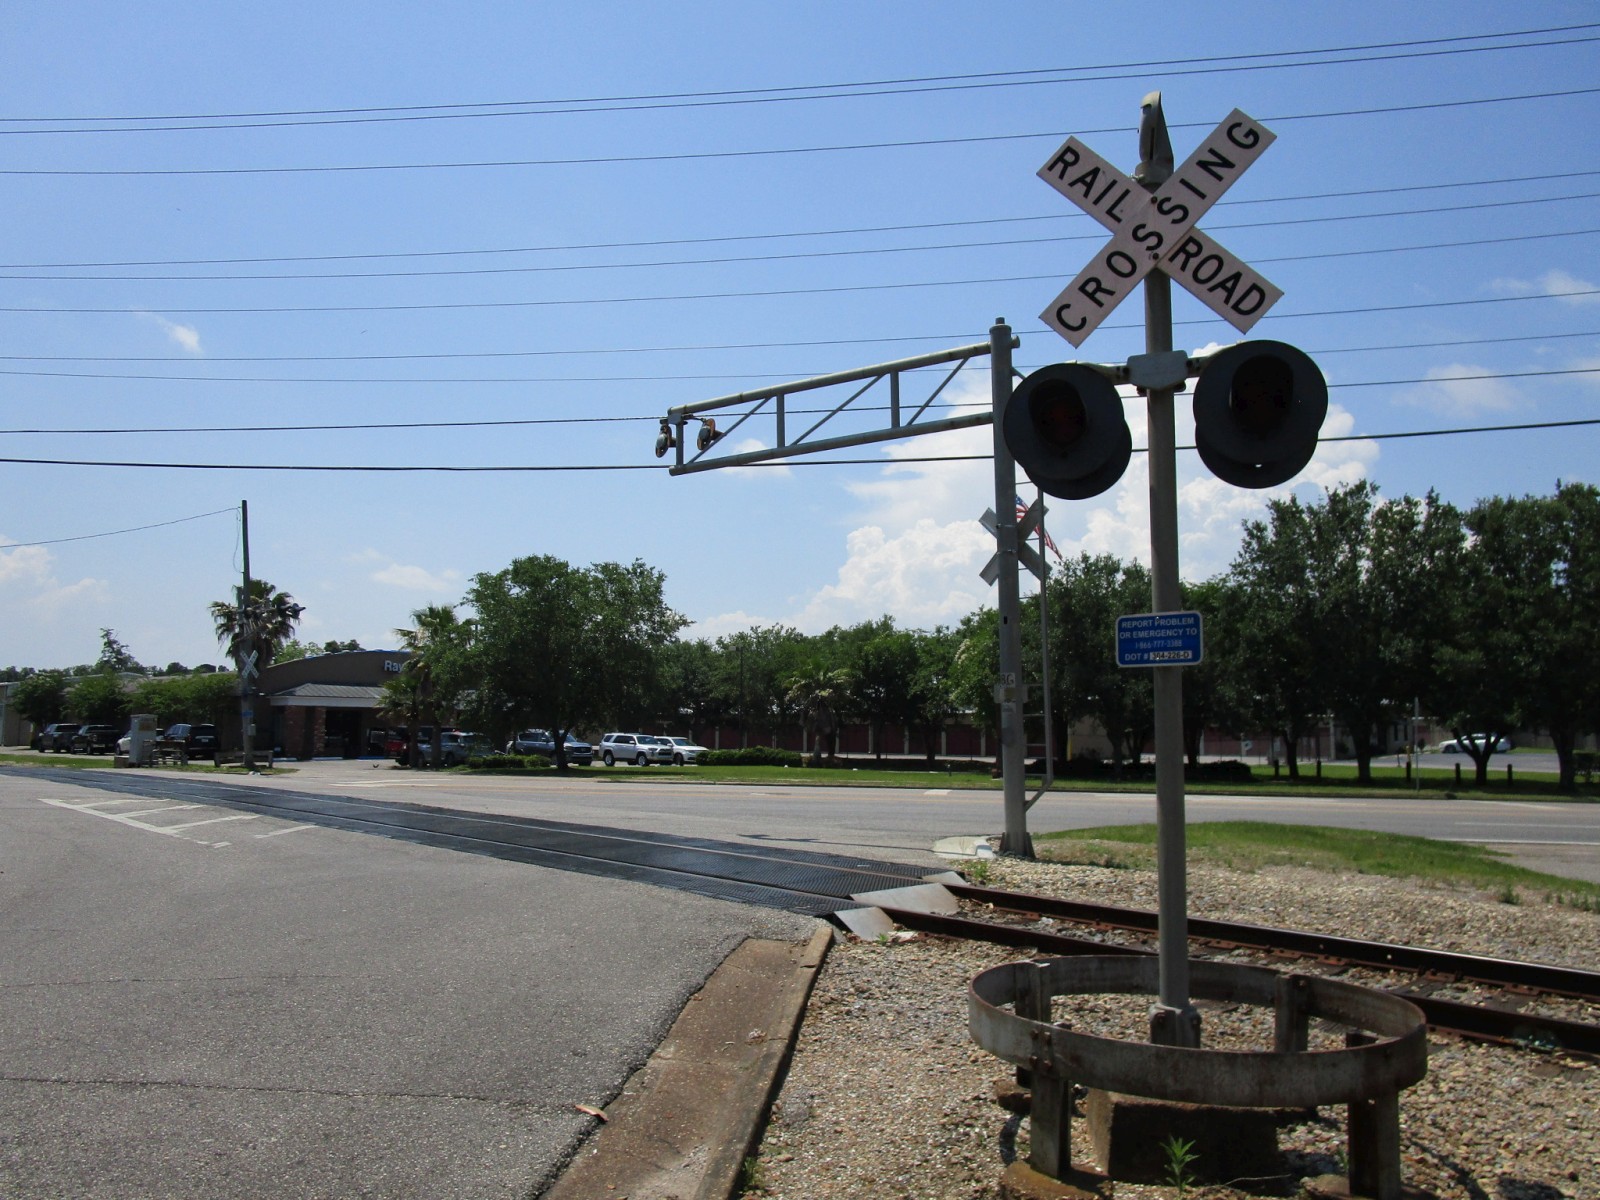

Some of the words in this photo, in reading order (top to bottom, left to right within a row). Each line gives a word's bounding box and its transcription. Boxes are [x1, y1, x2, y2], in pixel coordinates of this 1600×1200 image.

[1047, 145, 1131, 223] RAIL
[1056, 121, 1260, 332] CROSSING
[1168, 235, 1266, 316] ROAD
[1122, 620, 1153, 628] REPORT
[1154, 617, 1194, 627] PROBLEM
[1133, 629, 1183, 638] EMERGENCY
